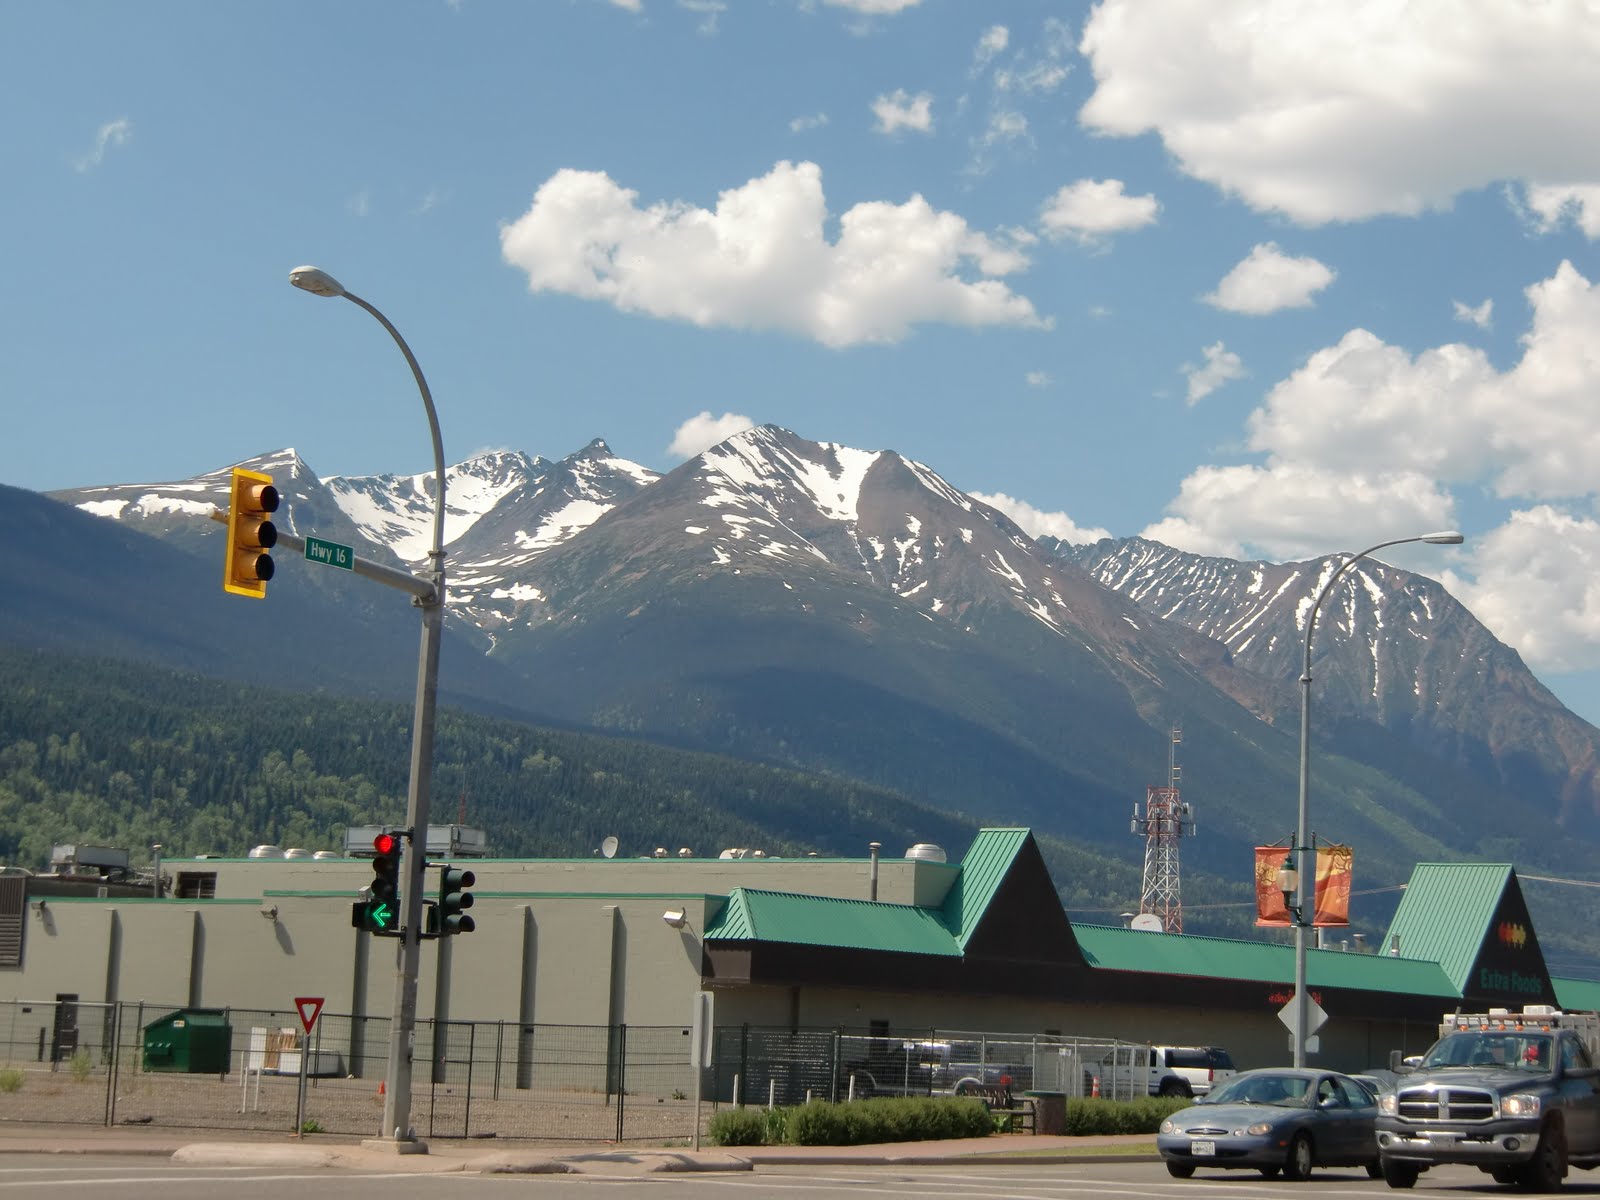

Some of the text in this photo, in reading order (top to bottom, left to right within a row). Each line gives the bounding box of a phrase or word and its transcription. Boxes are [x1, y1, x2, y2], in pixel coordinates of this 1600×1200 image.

[311, 542, 346, 563] Hwy 16
[1480, 968, 1542, 994] Extra Foods
